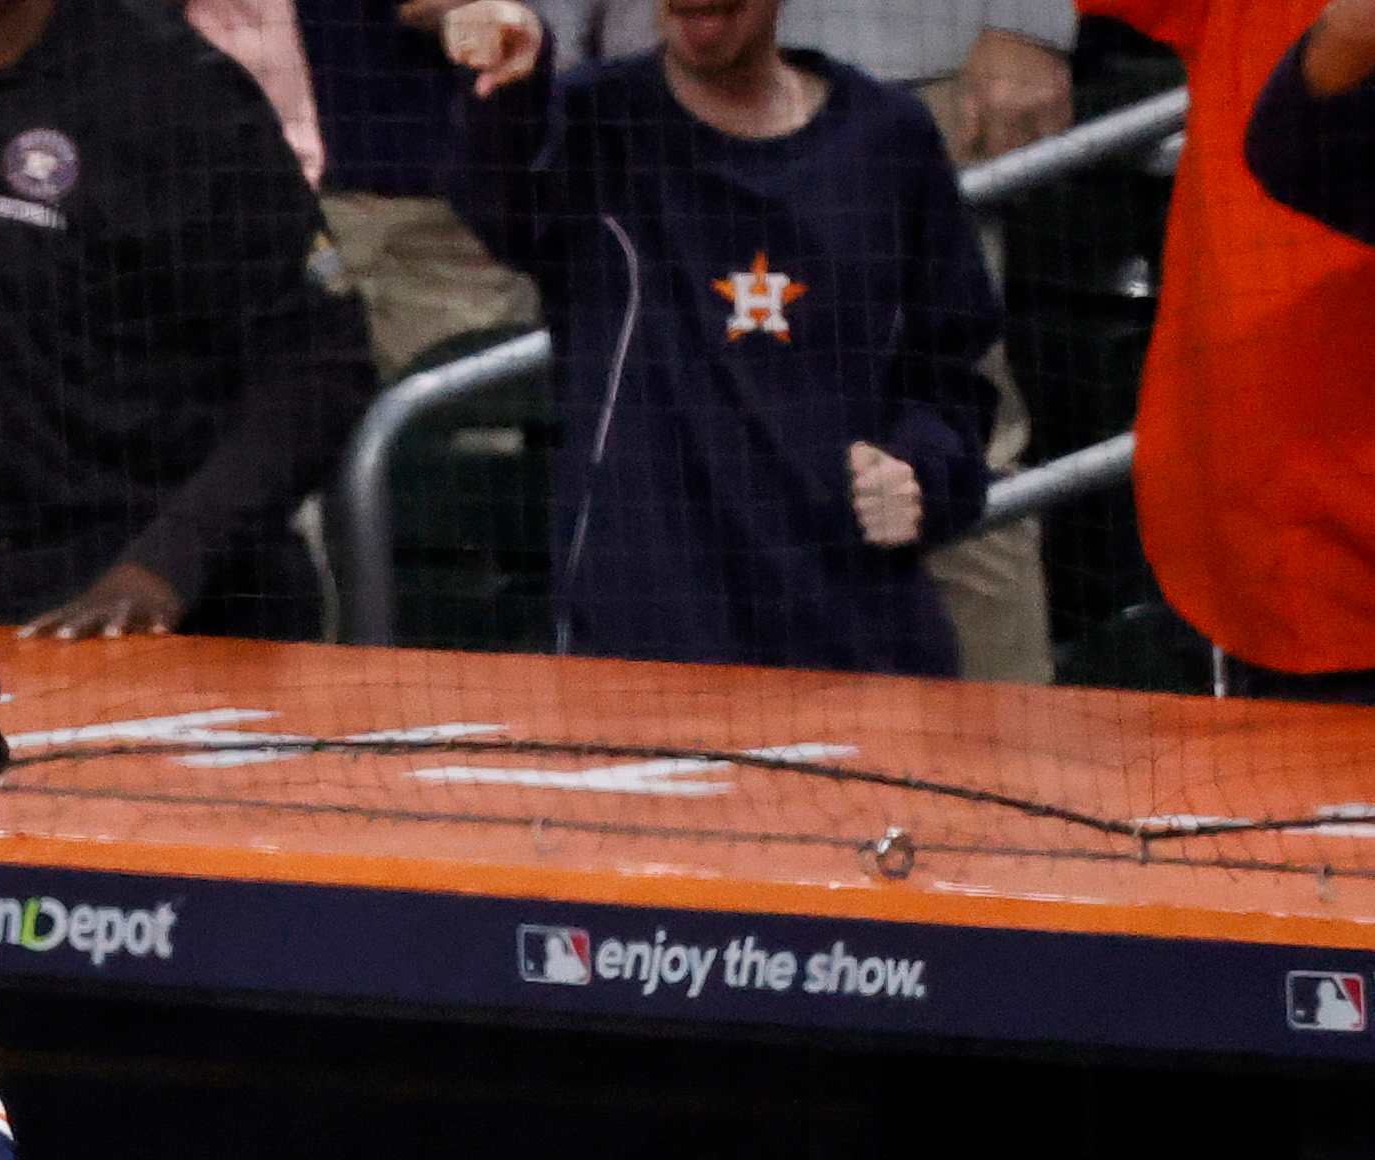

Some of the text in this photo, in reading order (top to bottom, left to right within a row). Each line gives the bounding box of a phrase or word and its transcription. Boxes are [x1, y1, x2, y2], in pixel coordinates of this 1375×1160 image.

[596, 928, 926, 998] enjoy the show.
